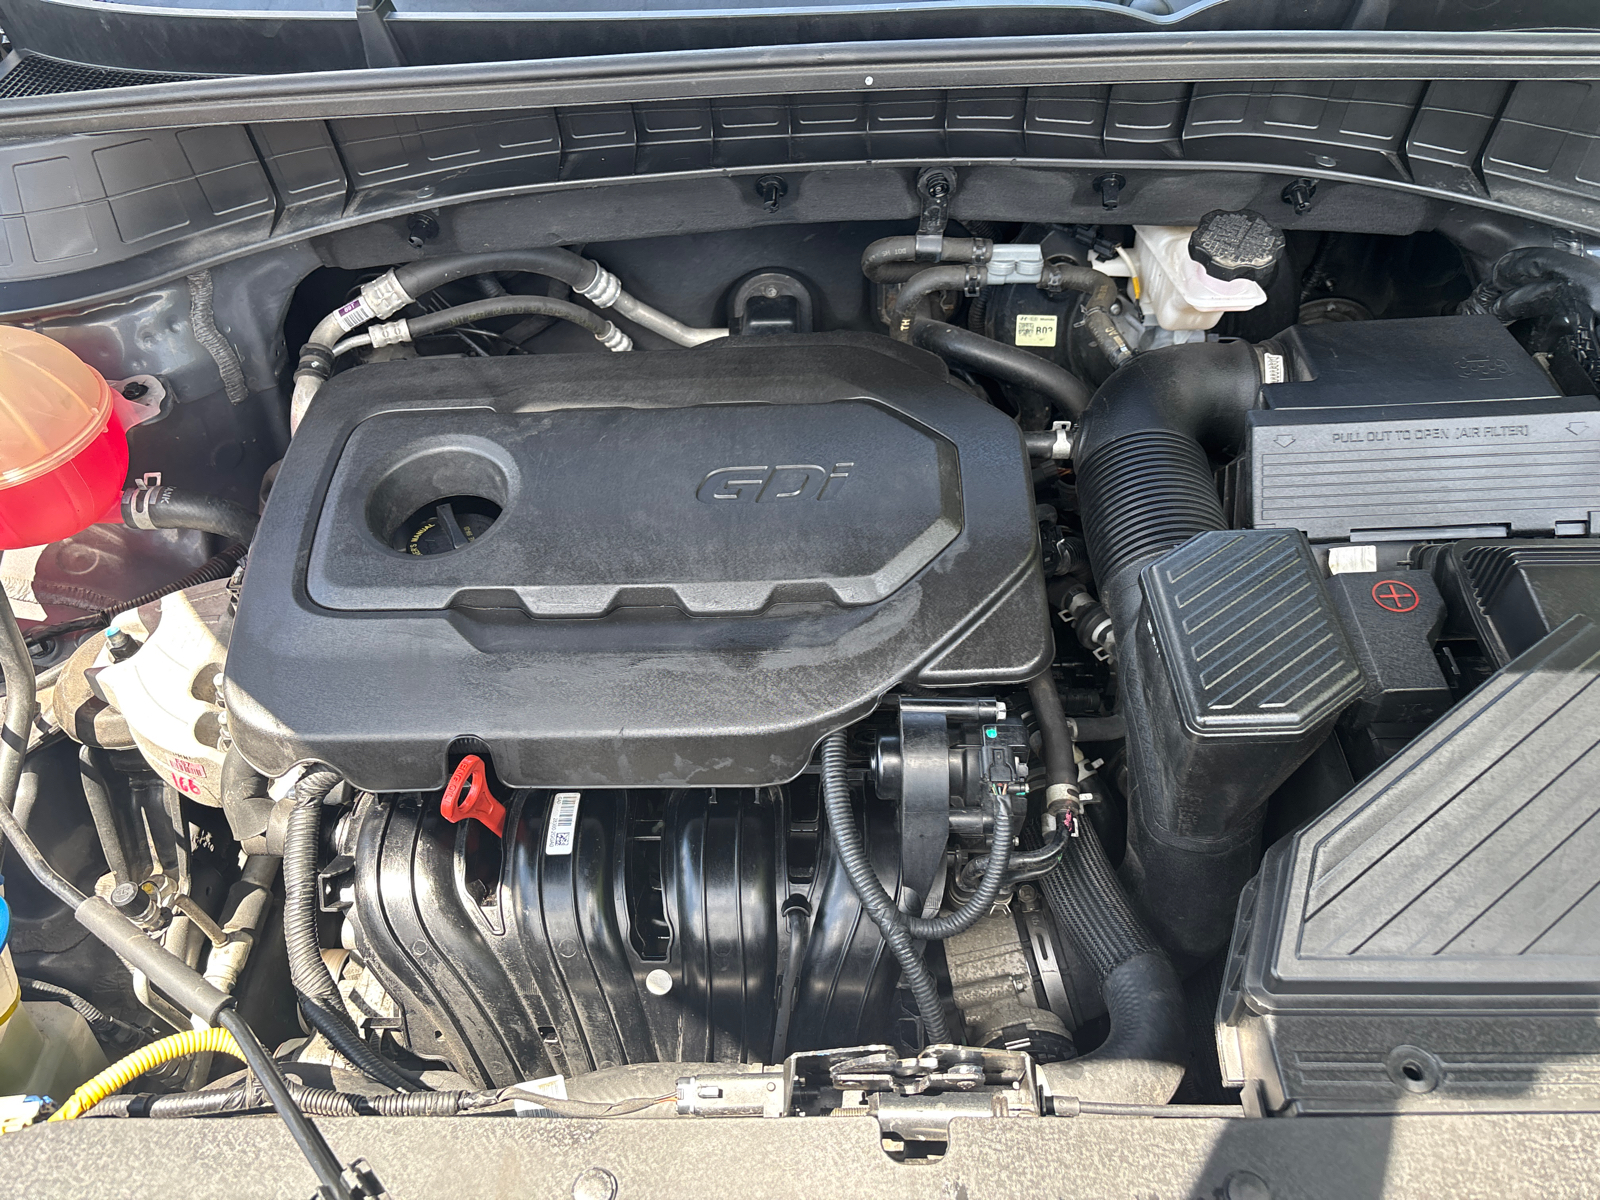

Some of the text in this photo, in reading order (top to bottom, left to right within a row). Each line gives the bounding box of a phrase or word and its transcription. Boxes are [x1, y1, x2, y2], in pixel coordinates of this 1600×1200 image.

[1332, 432, 1363, 444] PULL
[1366, 430, 1392, 442] OUT
[1395, 429, 1411, 441] TO
[1414, 427, 1450, 440] OPEN
